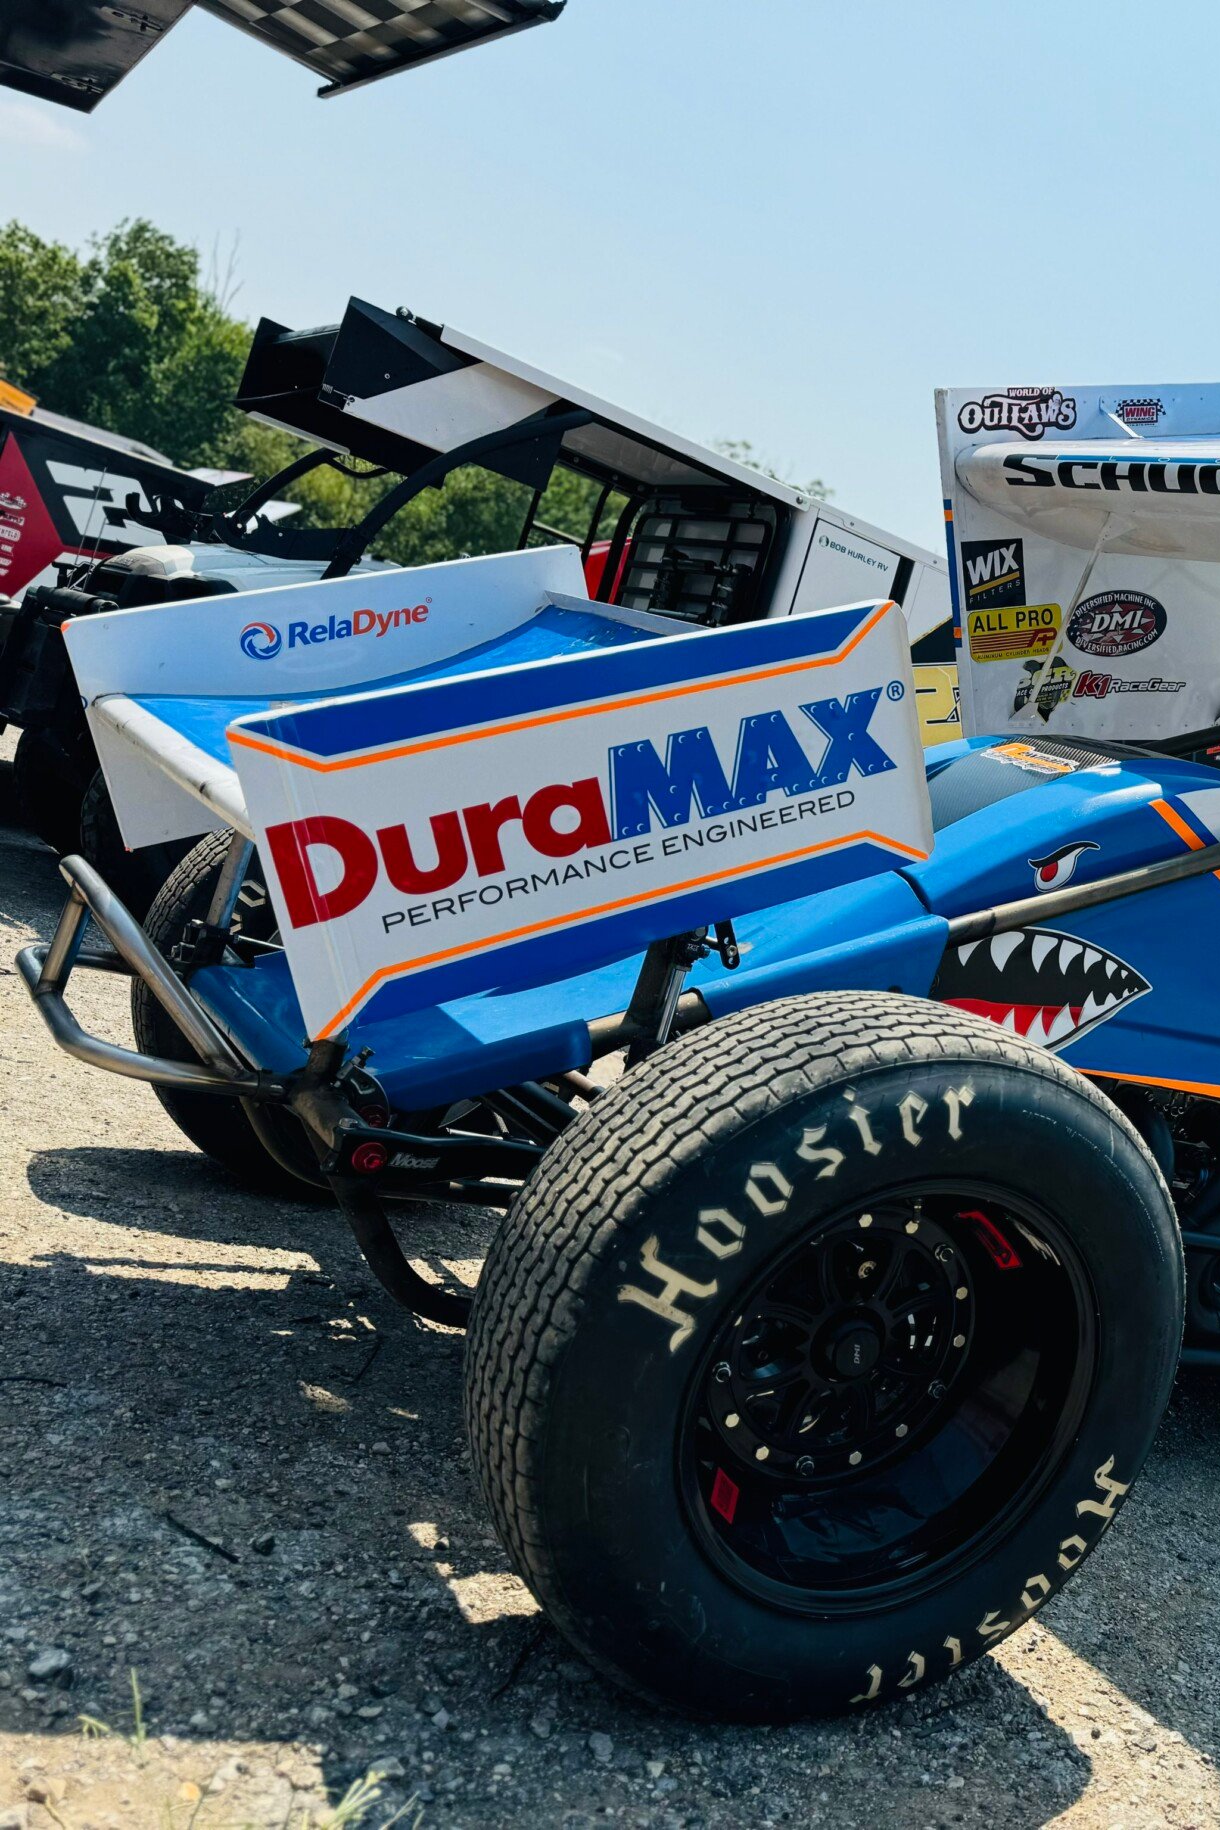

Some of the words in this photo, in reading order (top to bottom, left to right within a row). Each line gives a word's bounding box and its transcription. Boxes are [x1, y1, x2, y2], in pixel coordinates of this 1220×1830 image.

[1008, 388, 1040, 397] WORLD
[1042, 387, 1054, 395] OF
[959, 395, 1077, 440] OUTLAWS
[1125, 407, 1155, 418] WING
[829, 541, 847, 554] BOB
[847, 549, 877, 566] HURLEY
[877, 562, 889, 572] RV
[966, 543, 1020, 586] WIX
[969, 579, 1021, 604] FILTERS
[1075, 594, 1113, 618] DIVERSIFIED
[1114, 593, 1144, 604] MACHINE
[1144, 597, 1157, 609] INC
[288, 604, 429, 649] RelaDyne
[973, 612, 1008, 633] ALL
[1015, 608, 1053, 628] PRO
[1090, 609, 1144, 633] DMI
[266, 686, 898, 930] DuraMAX
[381, 842, 655, 934] PERFORMANCE
[662, 789, 856, 857] ENGINEERED
[618, 1075, 974, 1353] Hoosier
